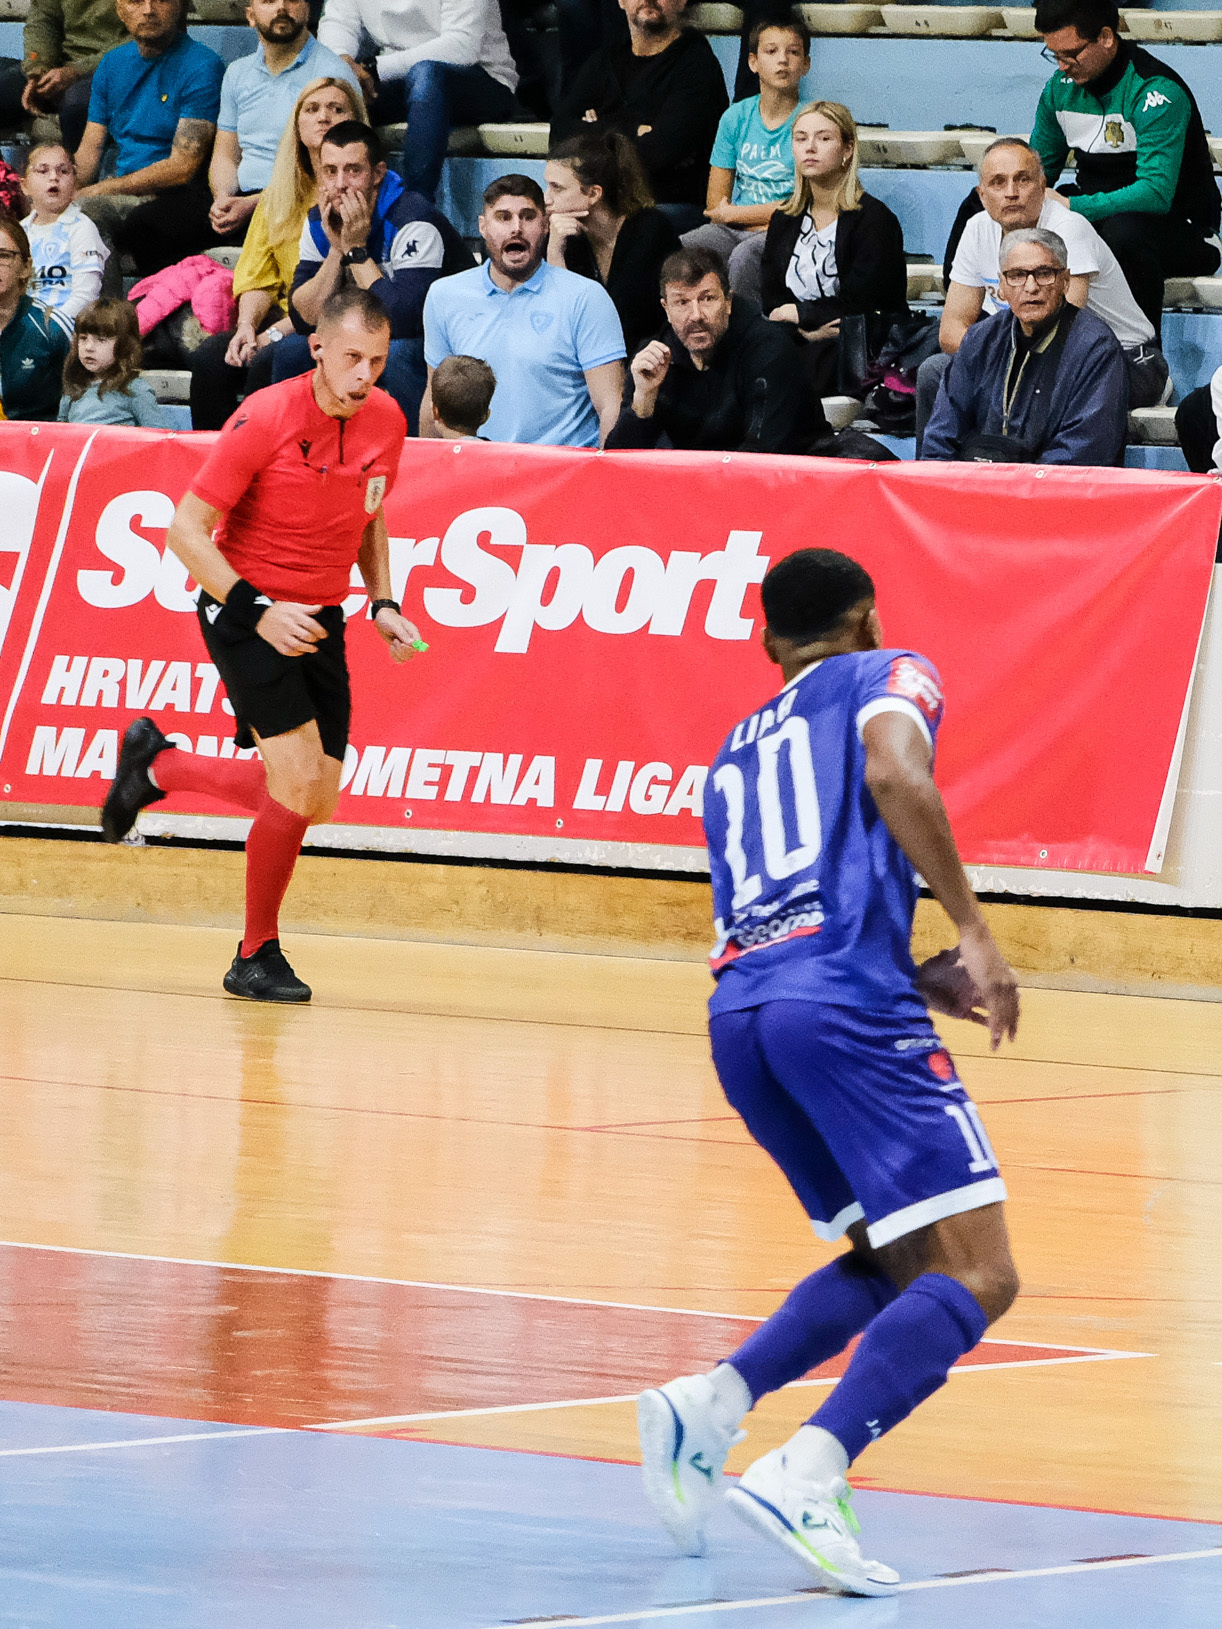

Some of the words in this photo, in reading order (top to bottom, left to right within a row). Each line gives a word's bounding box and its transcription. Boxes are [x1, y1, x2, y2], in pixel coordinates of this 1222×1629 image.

[77, 490, 771, 654] SrSport
[40, 655, 237, 717] HRVAT
[573, 758, 710, 818] LIGA
[713, 715, 822, 910] 10
